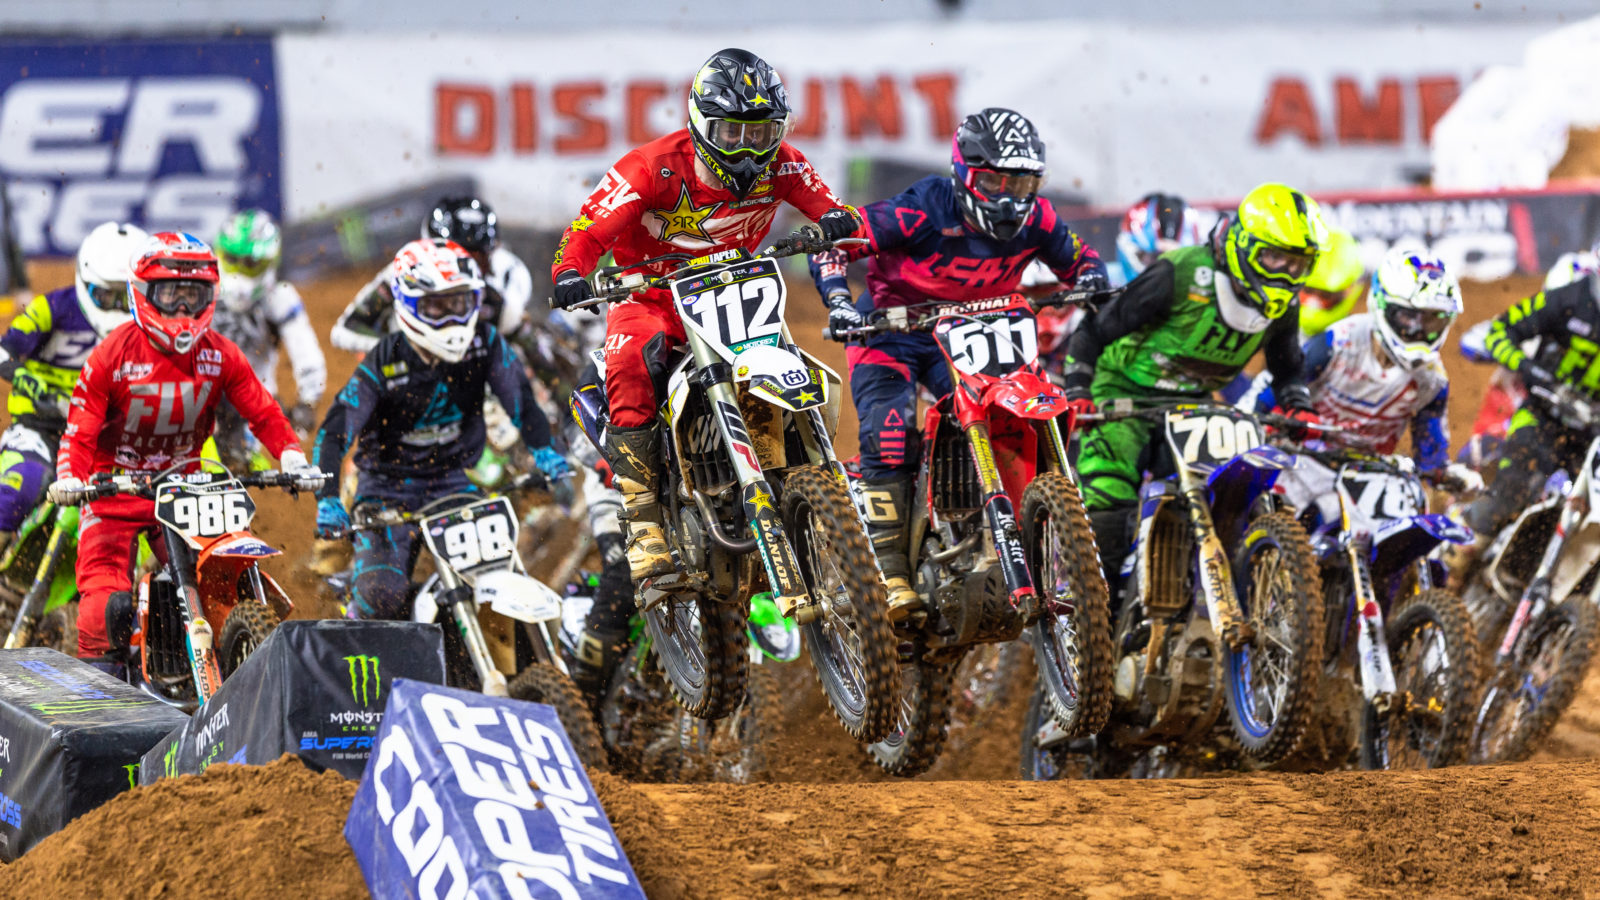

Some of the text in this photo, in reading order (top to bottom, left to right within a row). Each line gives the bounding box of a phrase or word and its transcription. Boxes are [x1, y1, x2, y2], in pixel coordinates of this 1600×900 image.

[434, 72, 960, 156] DISCUNT
[692, 277, 783, 345] 112
[949, 318, 1038, 376] 511
[124, 381, 213, 435] FLY
[173, 493, 249, 537] 986
[444, 513, 513, 572] 98
